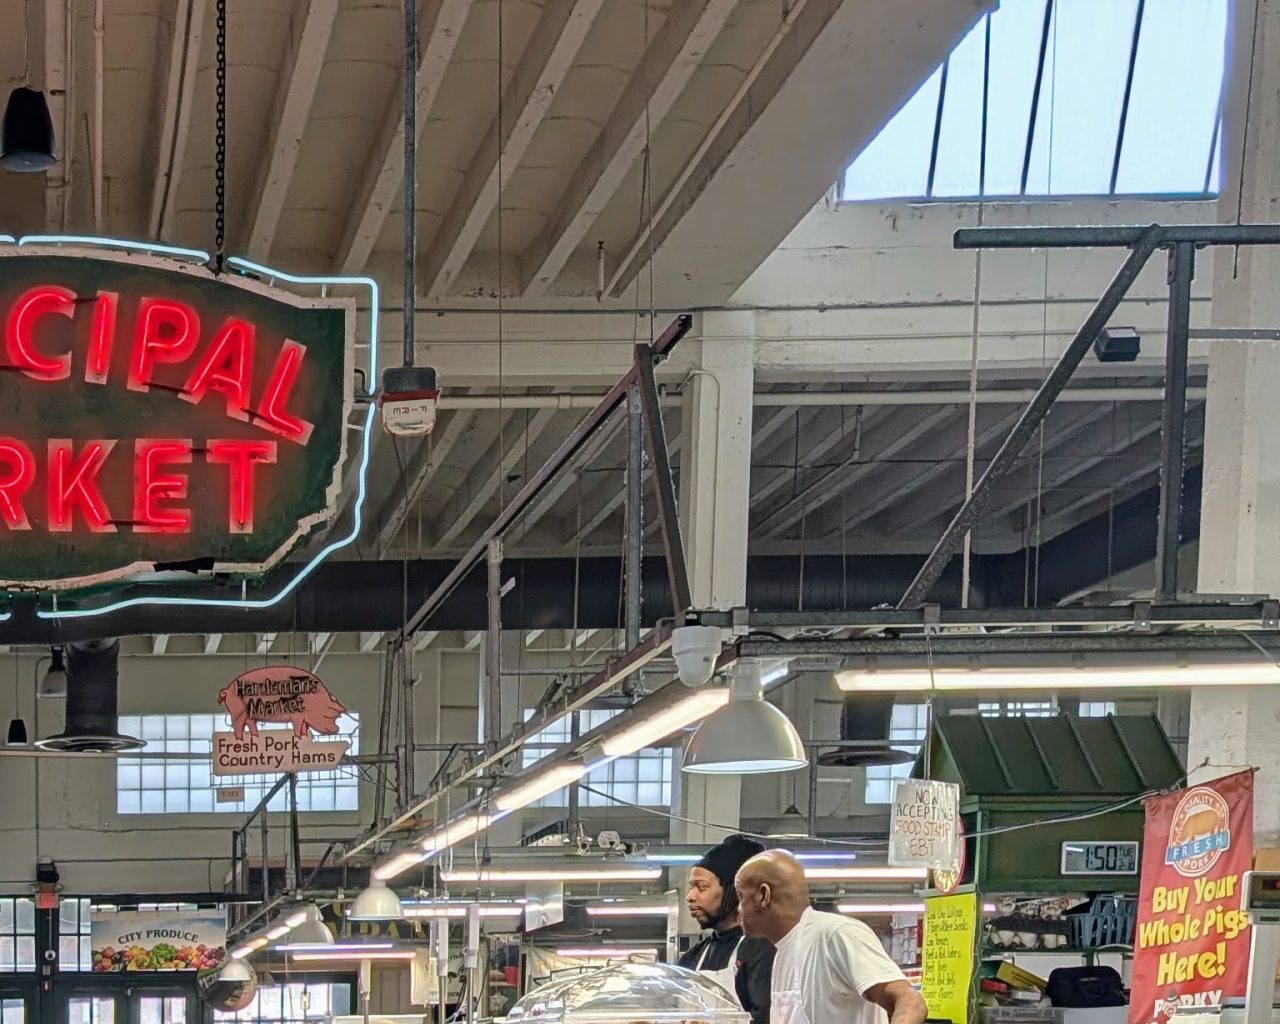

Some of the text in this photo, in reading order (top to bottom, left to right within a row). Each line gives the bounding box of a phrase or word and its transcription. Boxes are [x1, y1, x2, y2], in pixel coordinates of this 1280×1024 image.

[248, 697, 306, 719] Market
[218, 735, 300, 754] Fresh Pork
[219, 750, 336, 769] Country Hams
[896, 802, 954, 822] ACCEPTING
[1185, 795, 1214, 813] QUALITY
[896, 820, 921, 836] FOOD
[909, 838, 936, 857] EBT
[1172, 835, 1223, 860] FRESH
[1086, 845, 1118, 871] 1:50
[1183, 856, 1209, 870] PORK
[1151, 874, 1239, 914] Buy Your
[1139, 904, 1250, 949] Whole Pigs
[117, 929, 200, 945] CITY PRODUCE
[1156, 941, 1227, 987] Here!
[1153, 989, 1223, 1019] PRKY
